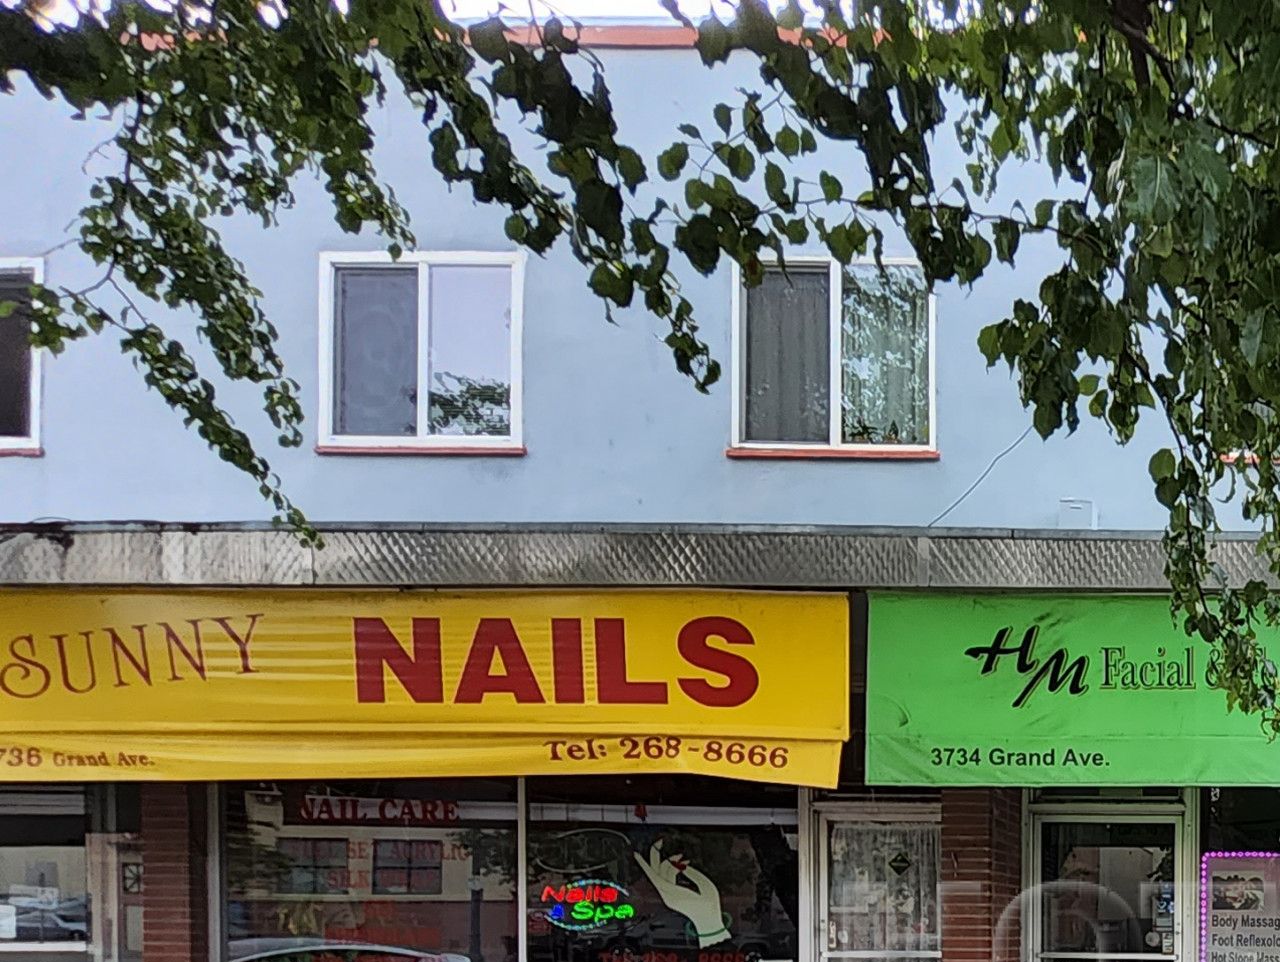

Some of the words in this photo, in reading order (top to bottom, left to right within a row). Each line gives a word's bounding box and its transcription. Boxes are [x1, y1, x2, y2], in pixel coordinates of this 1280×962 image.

[0, 613, 266, 698] SUNNY
[353, 616, 760, 707] NAILS
[1100, 645, 1197, 691] Facial
[53, 752, 110, 767] Grand
[117, 752, 156, 766] Ave.
[544, 739, 608, 761] Tel:
[931, 747, 982, 767] 3734
[988, 747, 1055, 767] Grand
[1062, 748, 1110, 767] Ave.
[301, 799, 367, 820] NAIL
[378, 799, 459, 820] CARE
[571, 901, 634, 923] Spa
[1211, 915, 1238, 930] Body
[1211, 934, 1234, 947] Foot
